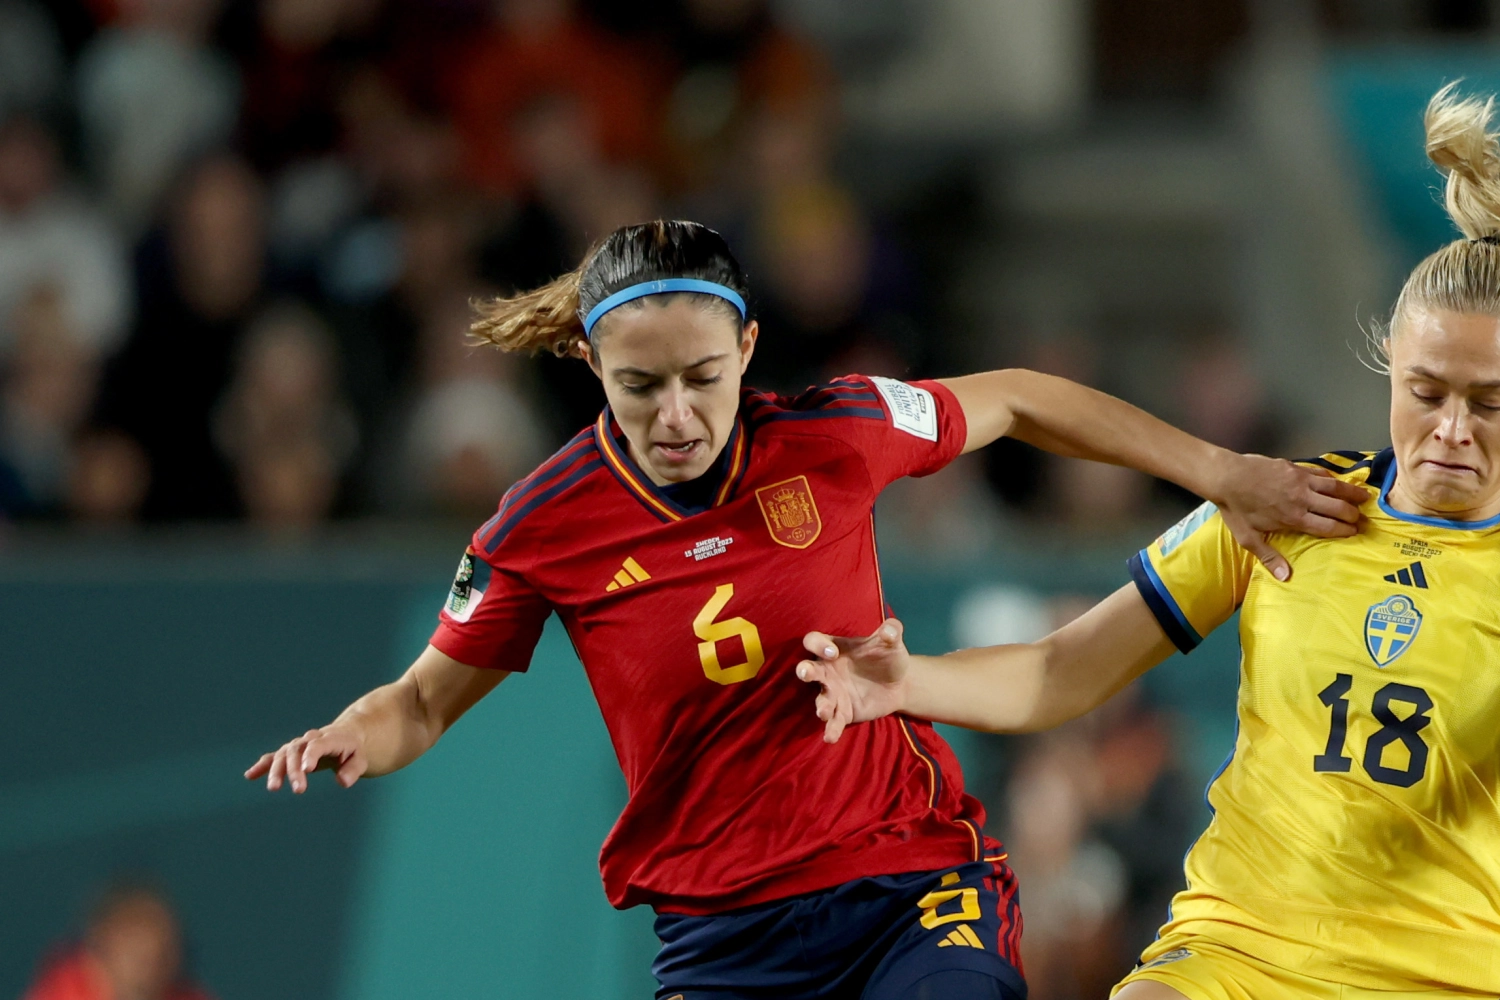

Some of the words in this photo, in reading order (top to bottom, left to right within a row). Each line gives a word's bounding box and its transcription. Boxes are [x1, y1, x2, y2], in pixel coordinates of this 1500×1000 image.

[892, 384, 914, 418] UNITES
[693, 543, 716, 555] AUGUST
[717, 537, 734, 547] 2023
[696, 536, 720, 547] SWEDEN
[1402, 543, 1426, 553] AUGUST
[1426, 548, 1443, 556] 2023
[1410, 538, 1429, 547] SPAIN
[695, 546, 727, 561] AUCKLAND
[1376, 613, 1412, 625] SVERIGE
[693, 583, 765, 686] 6
[1313, 672, 1434, 788] 18
[916, 871, 982, 931] 6
